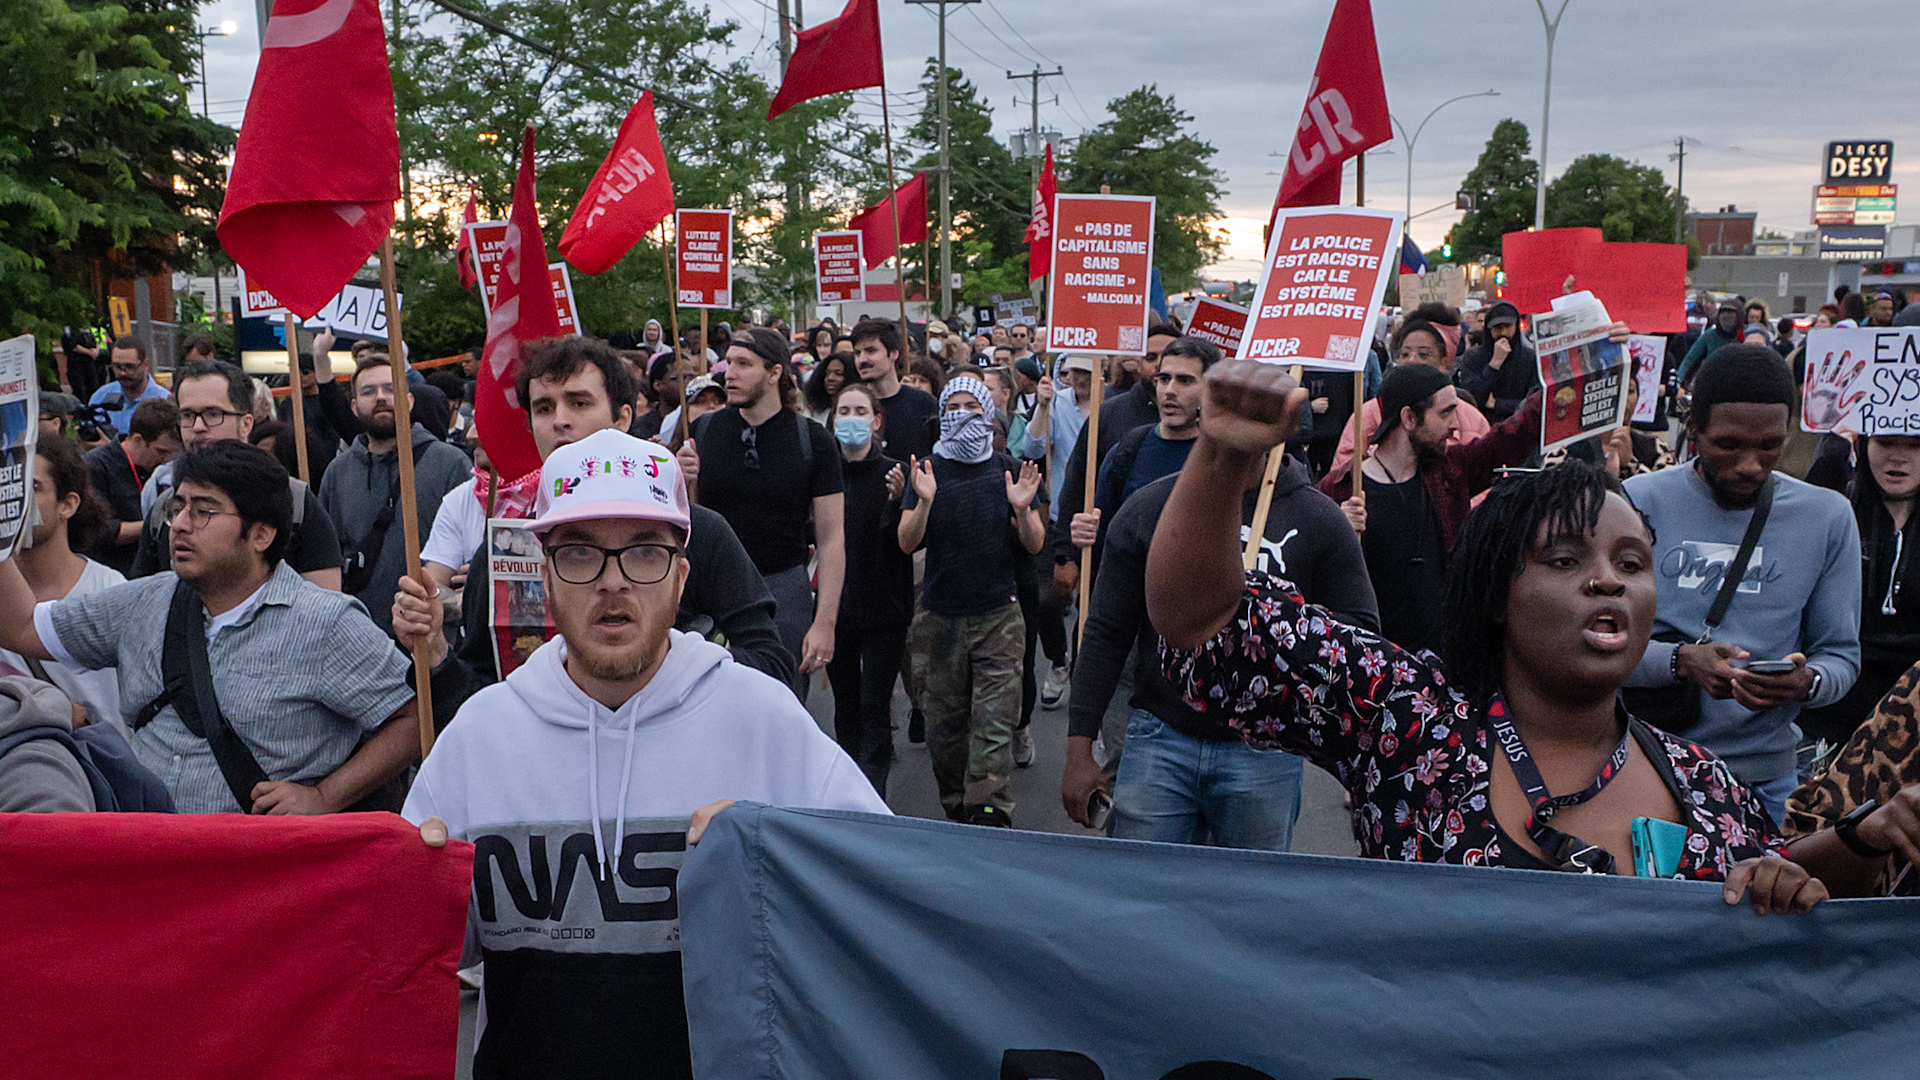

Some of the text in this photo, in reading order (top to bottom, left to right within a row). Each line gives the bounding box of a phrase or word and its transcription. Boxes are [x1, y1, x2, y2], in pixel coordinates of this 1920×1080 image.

[1835, 144, 1887, 156] PLACE
[1830, 156, 1889, 177] DESY
[685, 230, 721, 241] LUTTE DE
[1085, 222, 1111, 236] PAS
[1114, 224, 1132, 237] DE
[688, 241, 718, 251] CLASSE
[1058, 239, 1147, 255] CAPITALISME
[1290, 235, 1373, 252] LA POLICE
[683, 252, 724, 262] CONTRE LE
[1082, 256, 1120, 270] SANS
[1275, 252, 1380, 270] EST RACISTE
[685, 262, 720, 273] RACISME
[1065, 273, 1125, 287] RACISME
[1293, 269, 1351, 283] CAR LE
[1277, 283, 1357, 301] SYSTÈME
[1135, 295, 1143, 305] X
[1260, 302, 1366, 320] EST RACISTE
[1210, 322, 1230, 335] PAS
[1229, 327, 1243, 339] DE
[493, 558, 539, 574] RÉVOLUT
[1493, 721, 1528, 762] JESUS
